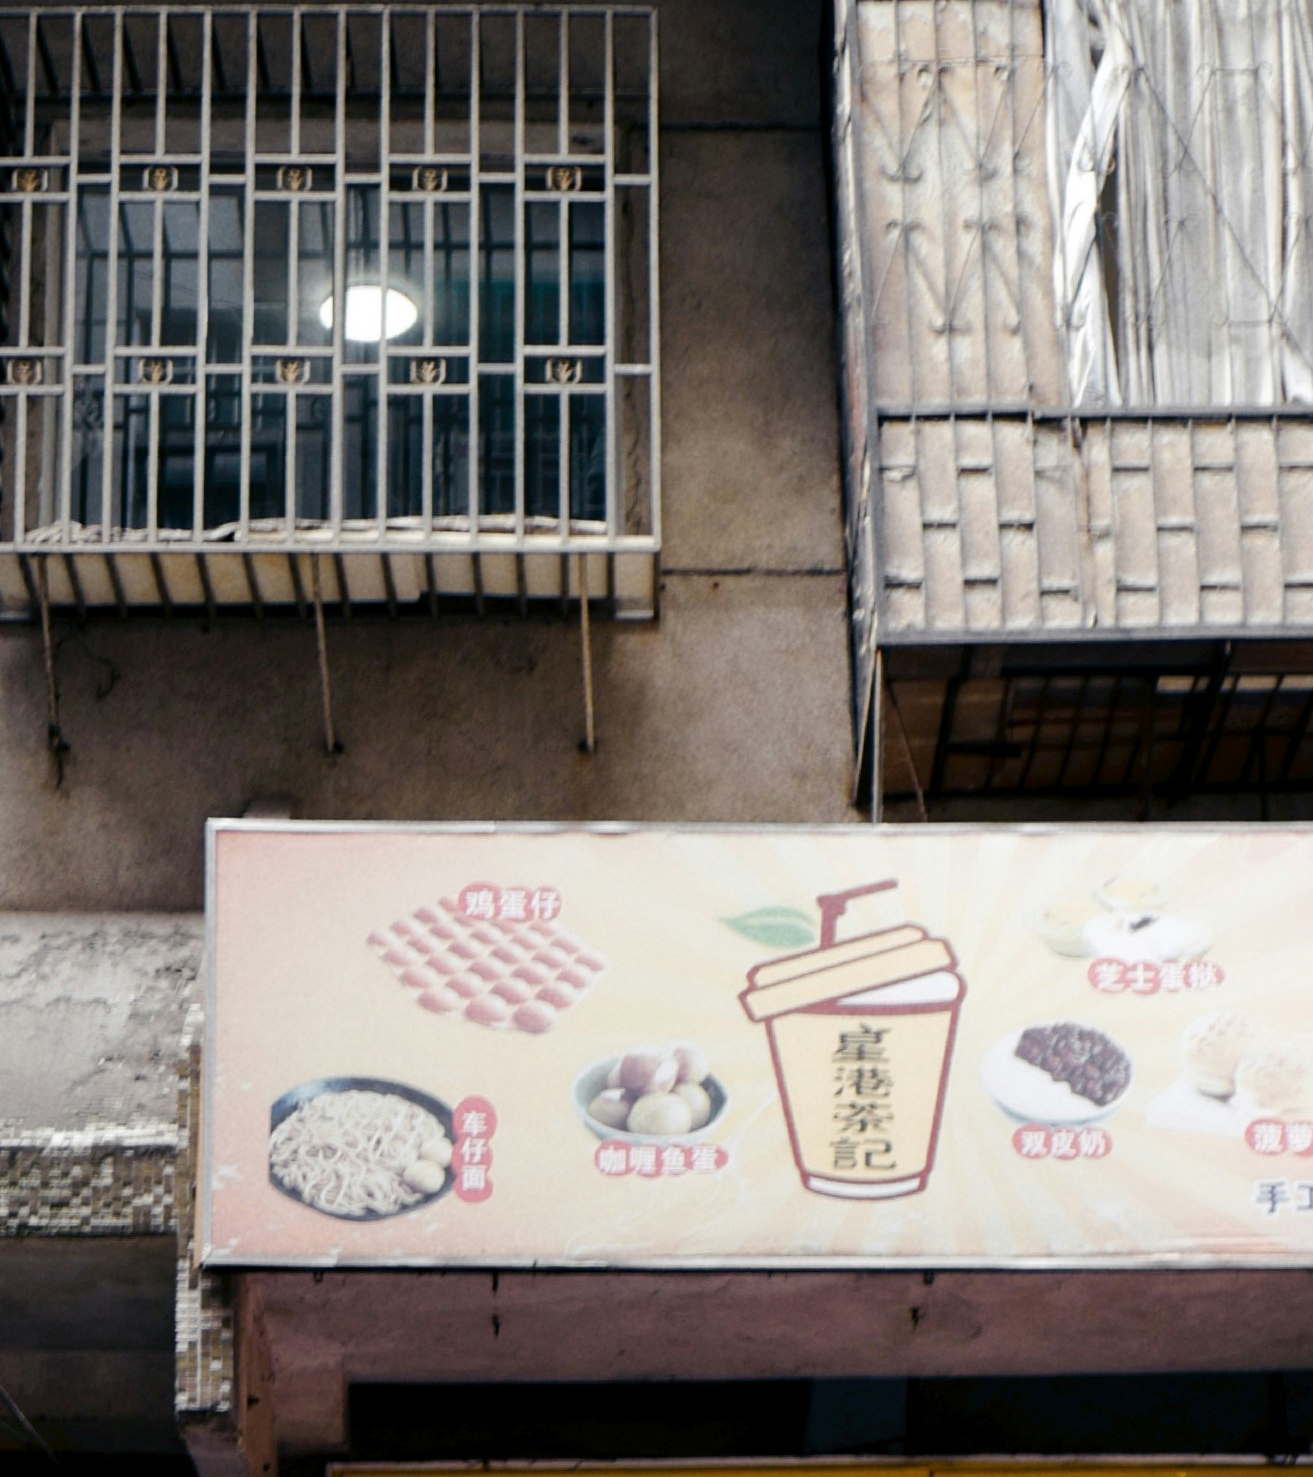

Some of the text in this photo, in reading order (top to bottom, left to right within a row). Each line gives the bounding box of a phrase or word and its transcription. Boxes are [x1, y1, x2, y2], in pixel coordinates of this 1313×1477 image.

[464, 887, 562, 920] 鸡蛋仔
[831, 1024, 897, 1172] 星港茶記
[461, 1110, 489, 1191] 车仔面
[598, 1144, 720, 1176] 咖喱鱼蛋
[1020, 1128, 1107, 1159] 双皮奶
